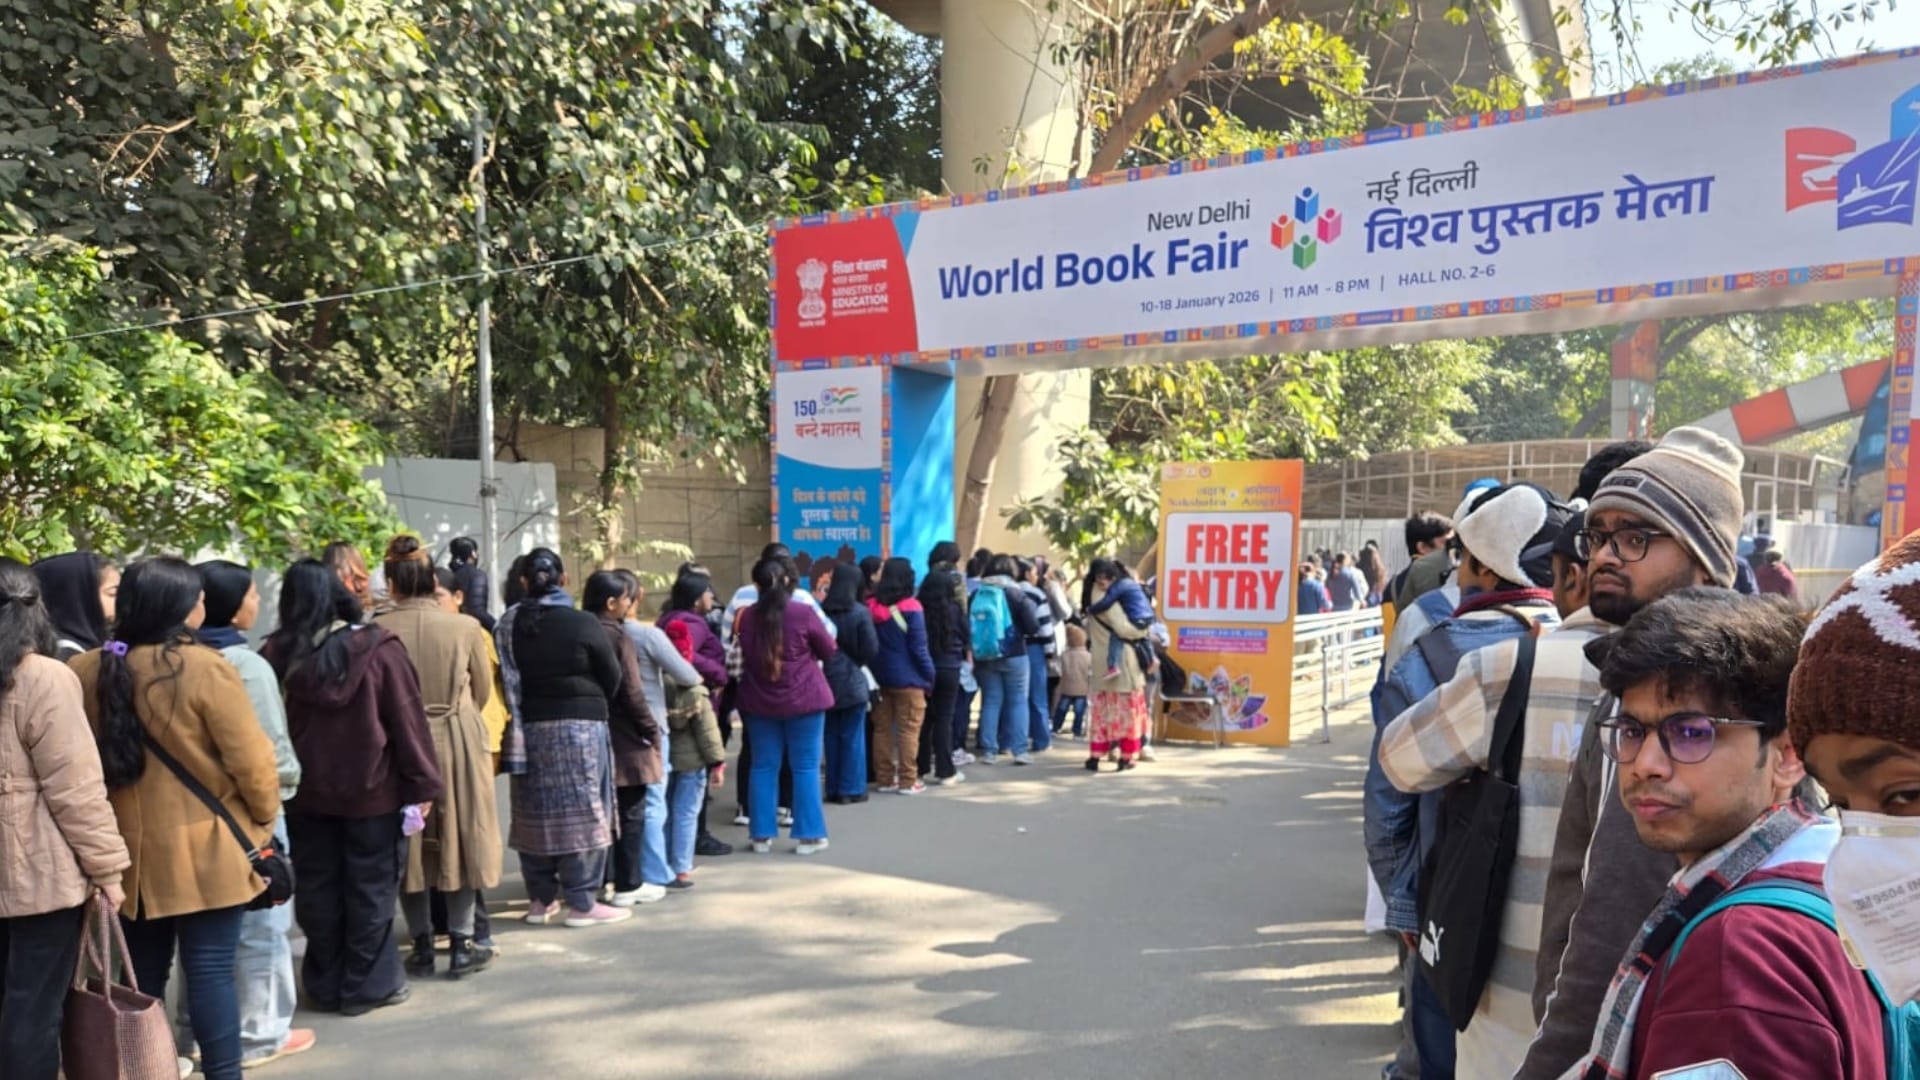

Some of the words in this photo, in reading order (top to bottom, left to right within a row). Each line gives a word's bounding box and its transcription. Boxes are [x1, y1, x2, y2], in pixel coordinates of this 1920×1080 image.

[1365, 171, 1401, 205] नई
[1407, 159, 1479, 198] दिल्ली
[1147, 211, 1194, 232] New
[1198, 199, 1250, 226] Delhi
[1364, 206, 1463, 253] विश्व
[1468, 191, 1604, 255] पुस्तक
[1614, 174, 1715, 222] मेला
[939, 256, 1044, 300] World
[1055, 244, 1155, 288] Book
[1167, 231, 1249, 276] Fair
[832, 284, 872, 297] MINISTRY
[874, 282, 887, 293] OF
[832, 294, 888, 309] EDUCATION
[1140, 299, 1172, 313] 10-18
[1175, 294, 1225, 309] January
[1228, 290, 1260, 304] 2026
[1283, 286, 1294, 299] 11
[1297, 283, 1318, 297] AM
[1335, 281, 1344, 293] 8
[1348, 279, 1369, 291] PM
[1398, 271, 1436, 286] HALL
[1441, 267, 1466, 281] NO.
[1469, 264, 1496, 278] 2-6
[794, 400, 817, 417] 150
[1186, 524, 1269, 564] FREE
[1168, 569, 1284, 611] ENTRY
